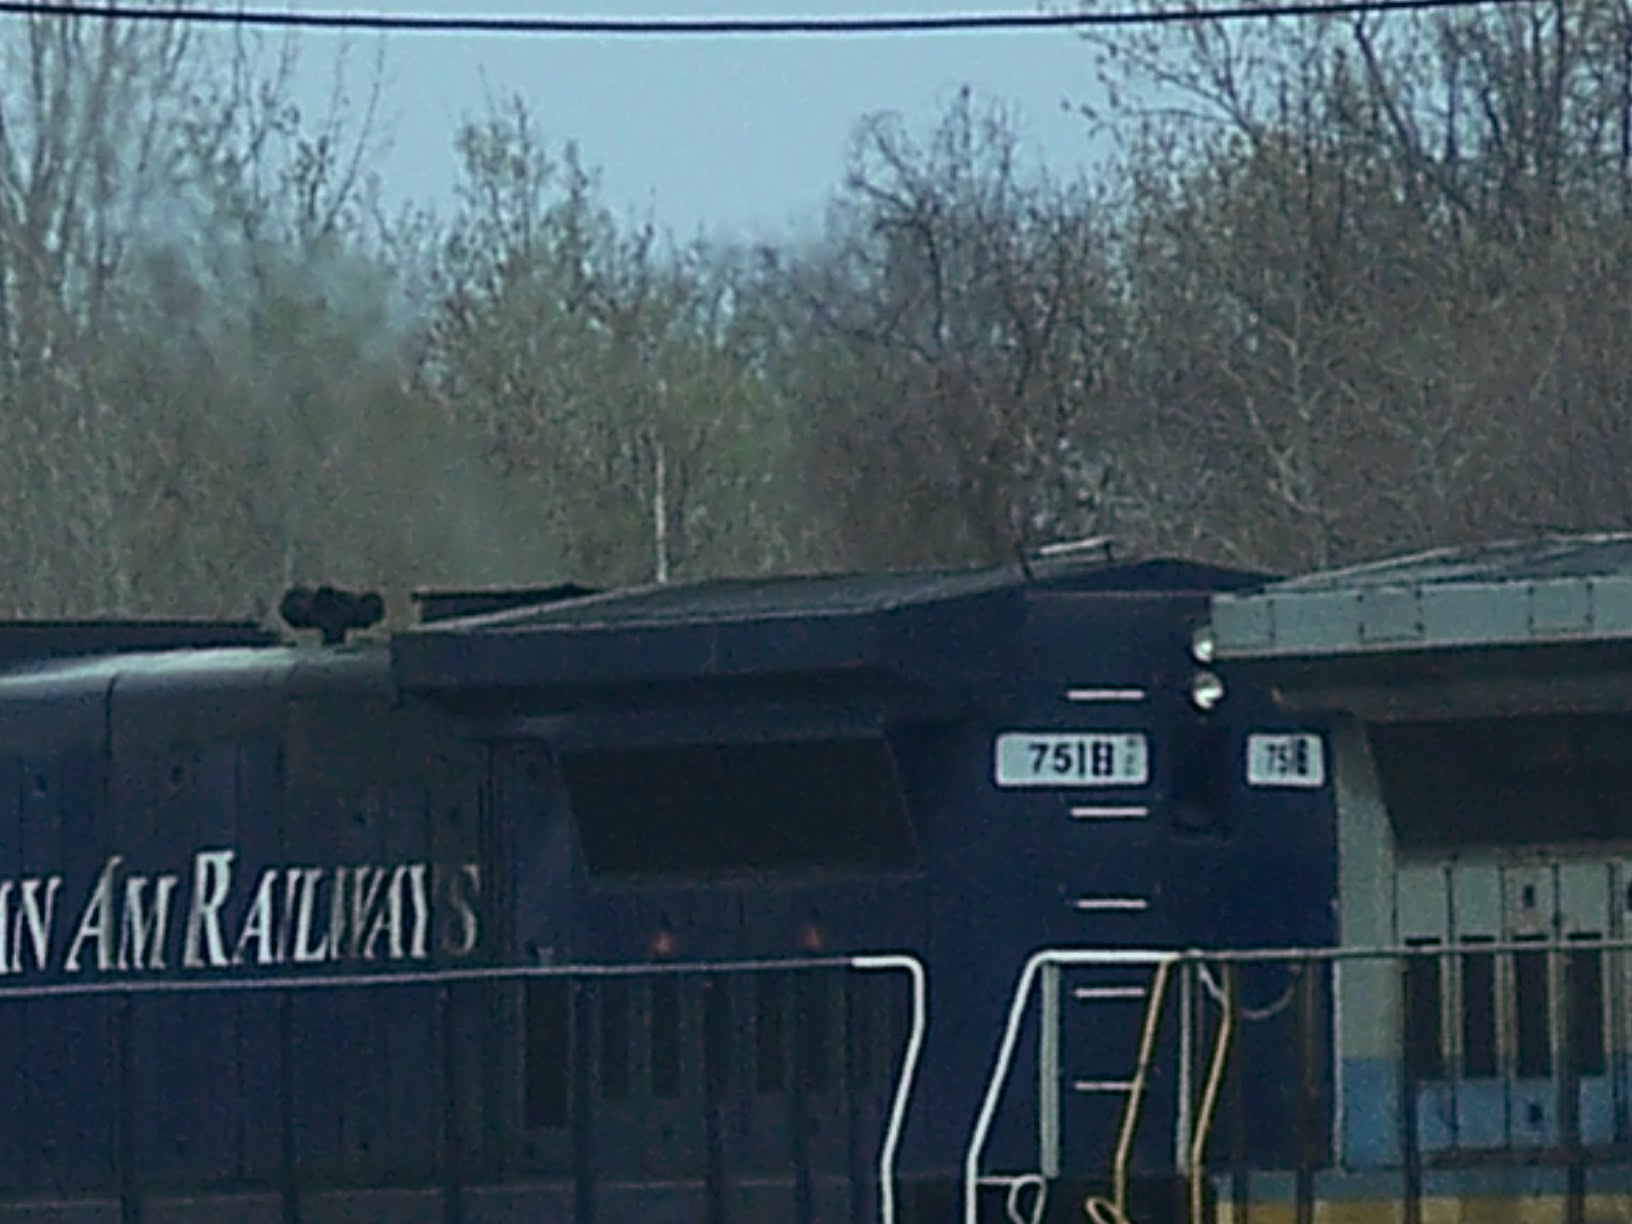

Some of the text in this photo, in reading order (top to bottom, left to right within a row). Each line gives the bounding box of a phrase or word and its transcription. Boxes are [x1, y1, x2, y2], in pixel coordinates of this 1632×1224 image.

[1029, 739, 1113, 777] 7518
[65, 855, 178, 972] AM
[182, 850, 482, 968] RAILWAYS
